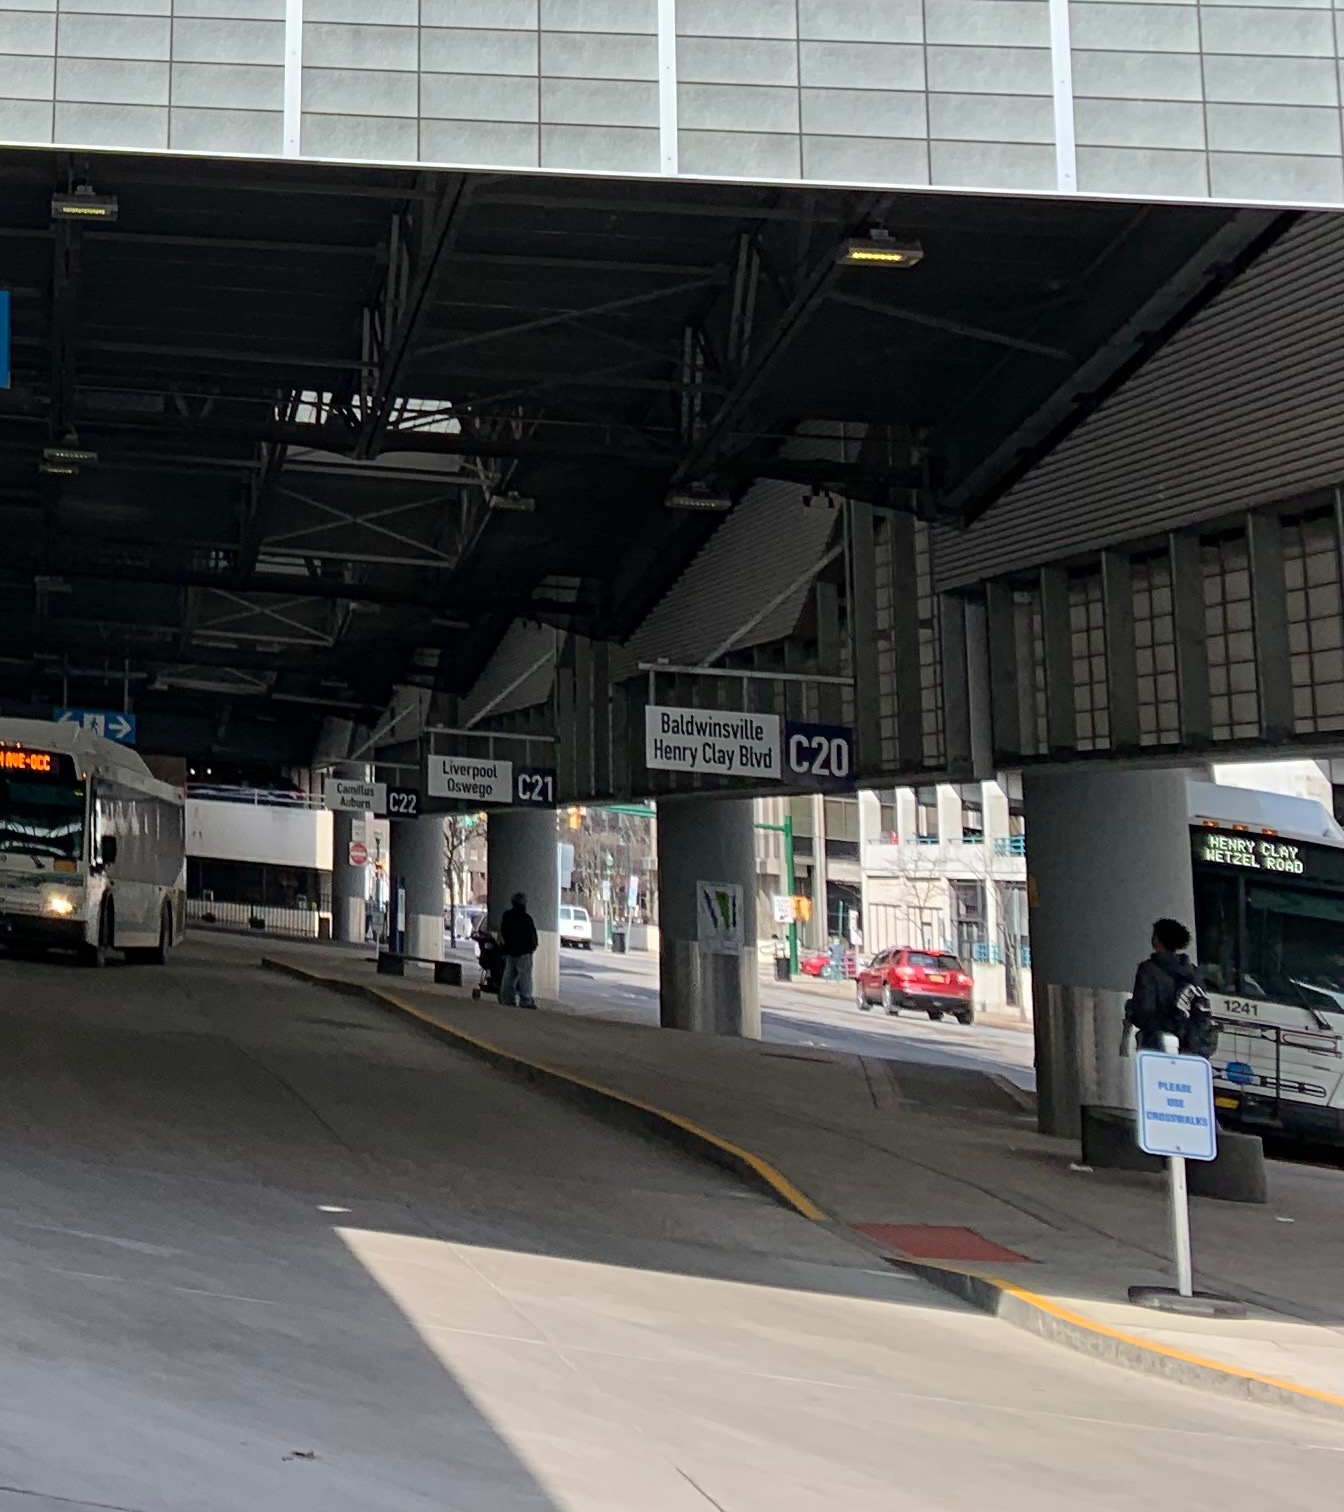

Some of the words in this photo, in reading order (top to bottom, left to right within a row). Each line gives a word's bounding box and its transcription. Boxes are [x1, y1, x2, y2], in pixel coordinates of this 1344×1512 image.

[660, 712, 764, 742] Baldwinsville
[654, 738, 698, 768] Henry
[702, 741, 735, 771] Clay
[739, 746, 773, 769] Blvd
[789, 734, 850, 778] C20
[442, 760, 498, 780] Liverpool
[447, 778, 493, 798] Oswego
[517, 773, 554, 803] C21
[339, 795, 372, 810] Auburn
[389, 791, 417, 814] C22
[1208, 833, 1256, 854] HENRY
[1261, 840, 1299, 860] CLAY
[1265, 856, 1305, 875] ROAD
[1223, 999, 1259, 1016] 1241
[1158, 1081, 1192, 1093] PLEASE
[1146, 1111, 1209, 1127] CROSSWALKS
